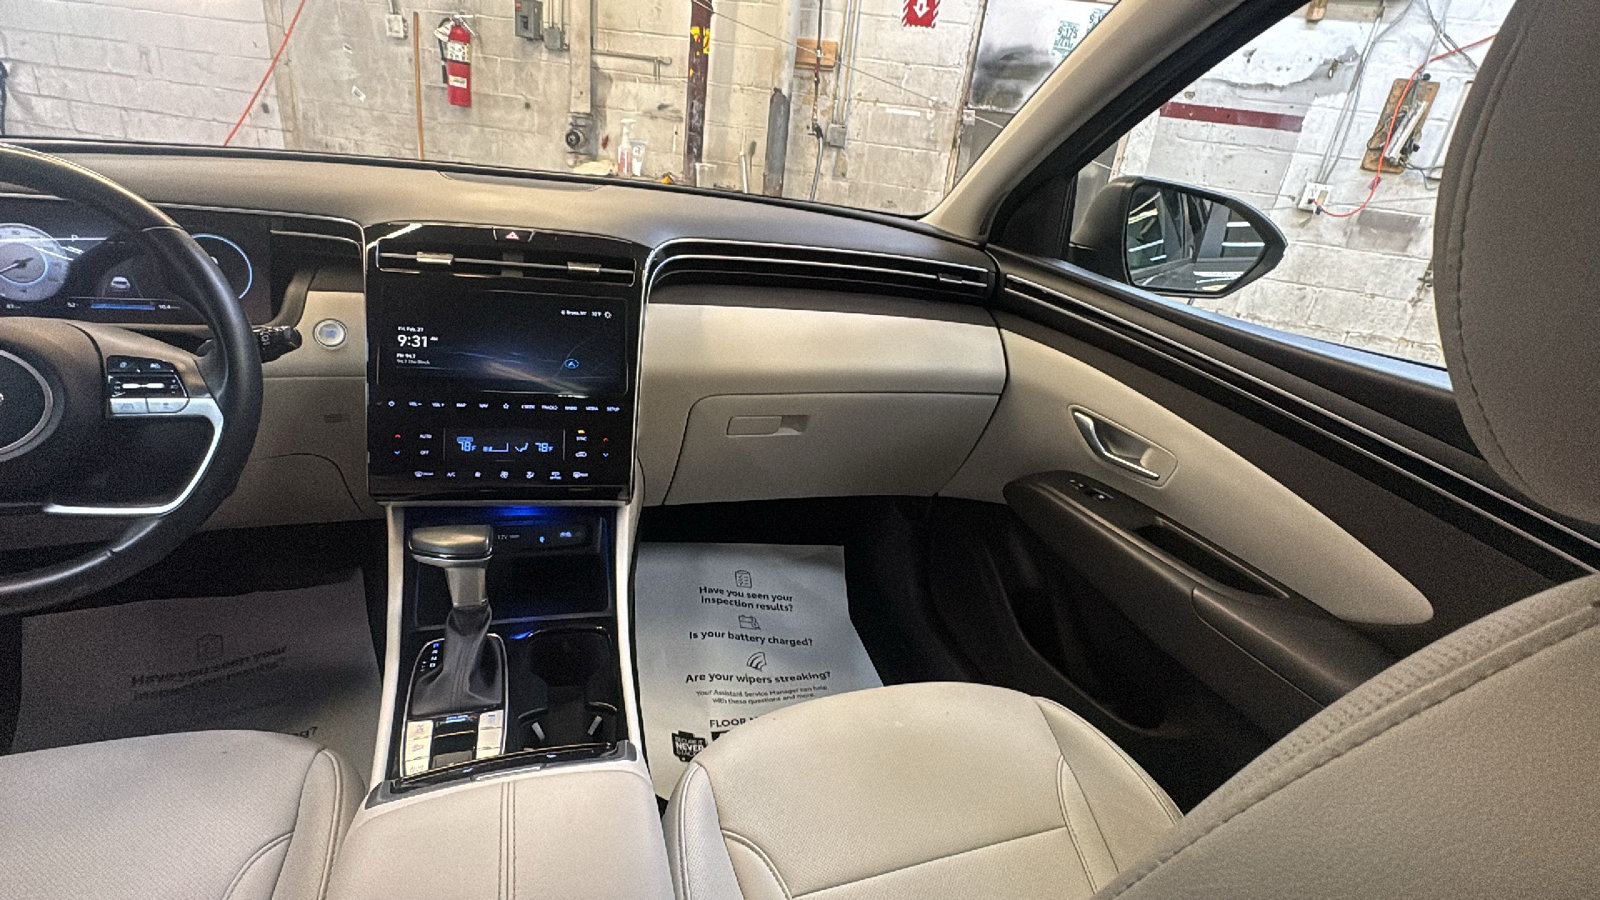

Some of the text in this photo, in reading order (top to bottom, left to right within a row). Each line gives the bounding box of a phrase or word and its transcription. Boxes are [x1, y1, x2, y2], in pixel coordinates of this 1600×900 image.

[398, 334, 428, 348] 9:31
[699, 586, 794, 602] Have you seen your
[701, 596, 794, 612] inspection results?
[689, 630, 813, 648] Is your battery charged?
[685, 671, 832, 686] Are your wipers streaking?
